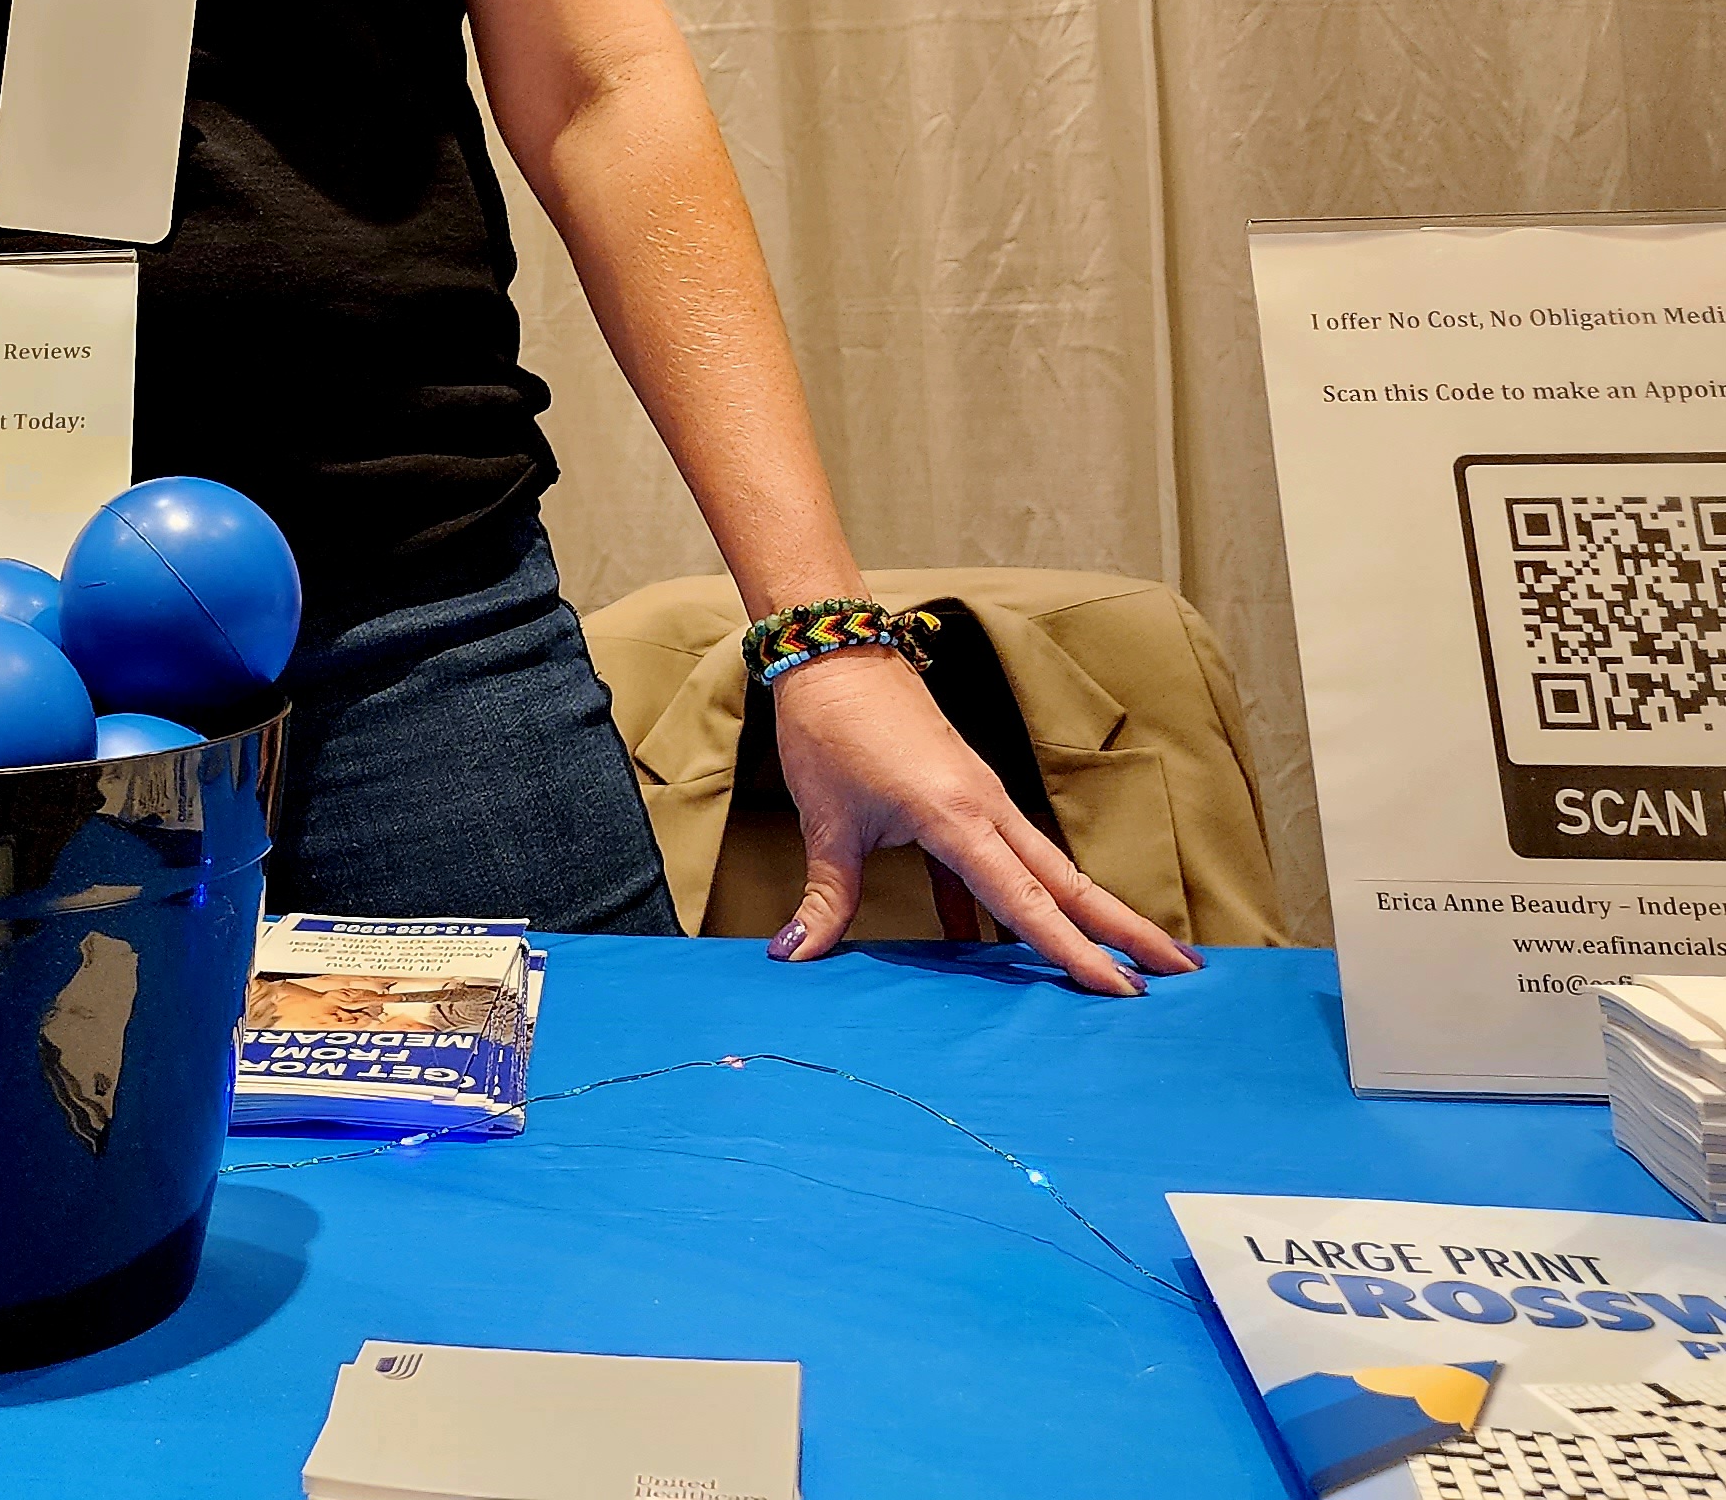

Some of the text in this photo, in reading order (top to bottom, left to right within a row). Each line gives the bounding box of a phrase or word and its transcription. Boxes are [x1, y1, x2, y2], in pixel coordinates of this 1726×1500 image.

[1309, 312, 1321, 331] I
[1325, 312, 1383, 331] offer
[1387, 311, 1421, 330] No
[1427, 309, 1485, 331] Cost,
[1489, 309, 1523, 329] No
[1529, 307, 1659, 332] Obligation
[3, 342, 93, 361] Reviews
[1322, 383, 1379, 404] Scan
[1384, 383, 1430, 403] this
[1435, 382, 1496, 402] Code
[1500, 384, 1527, 401] to
[1531, 381, 1602, 401] make
[1606, 385, 1637, 400] an
[13, 411, 87, 435] Today:
[1554, 787, 1709, 837] SCAN
[1375, 891, 1438, 912] Erica
[1443, 893, 1505, 914] Anne
[1510, 894, 1612, 920] Beaudry
[291, 947, 330, 955] and
[342, 943, 382, 951] with
[324, 955, 452, 965] navigate the
[325, 962, 363, 970] you
[369, 963, 414, 972] help
[270, 1046, 411, 1063] FROM
[356, 1063, 461, 1083] GET
[1243, 1234, 1612, 1286] LARGE PRINT
[1266, 1269, 1726, 1336] CROSSW
[636, 1474, 716, 1490] United
